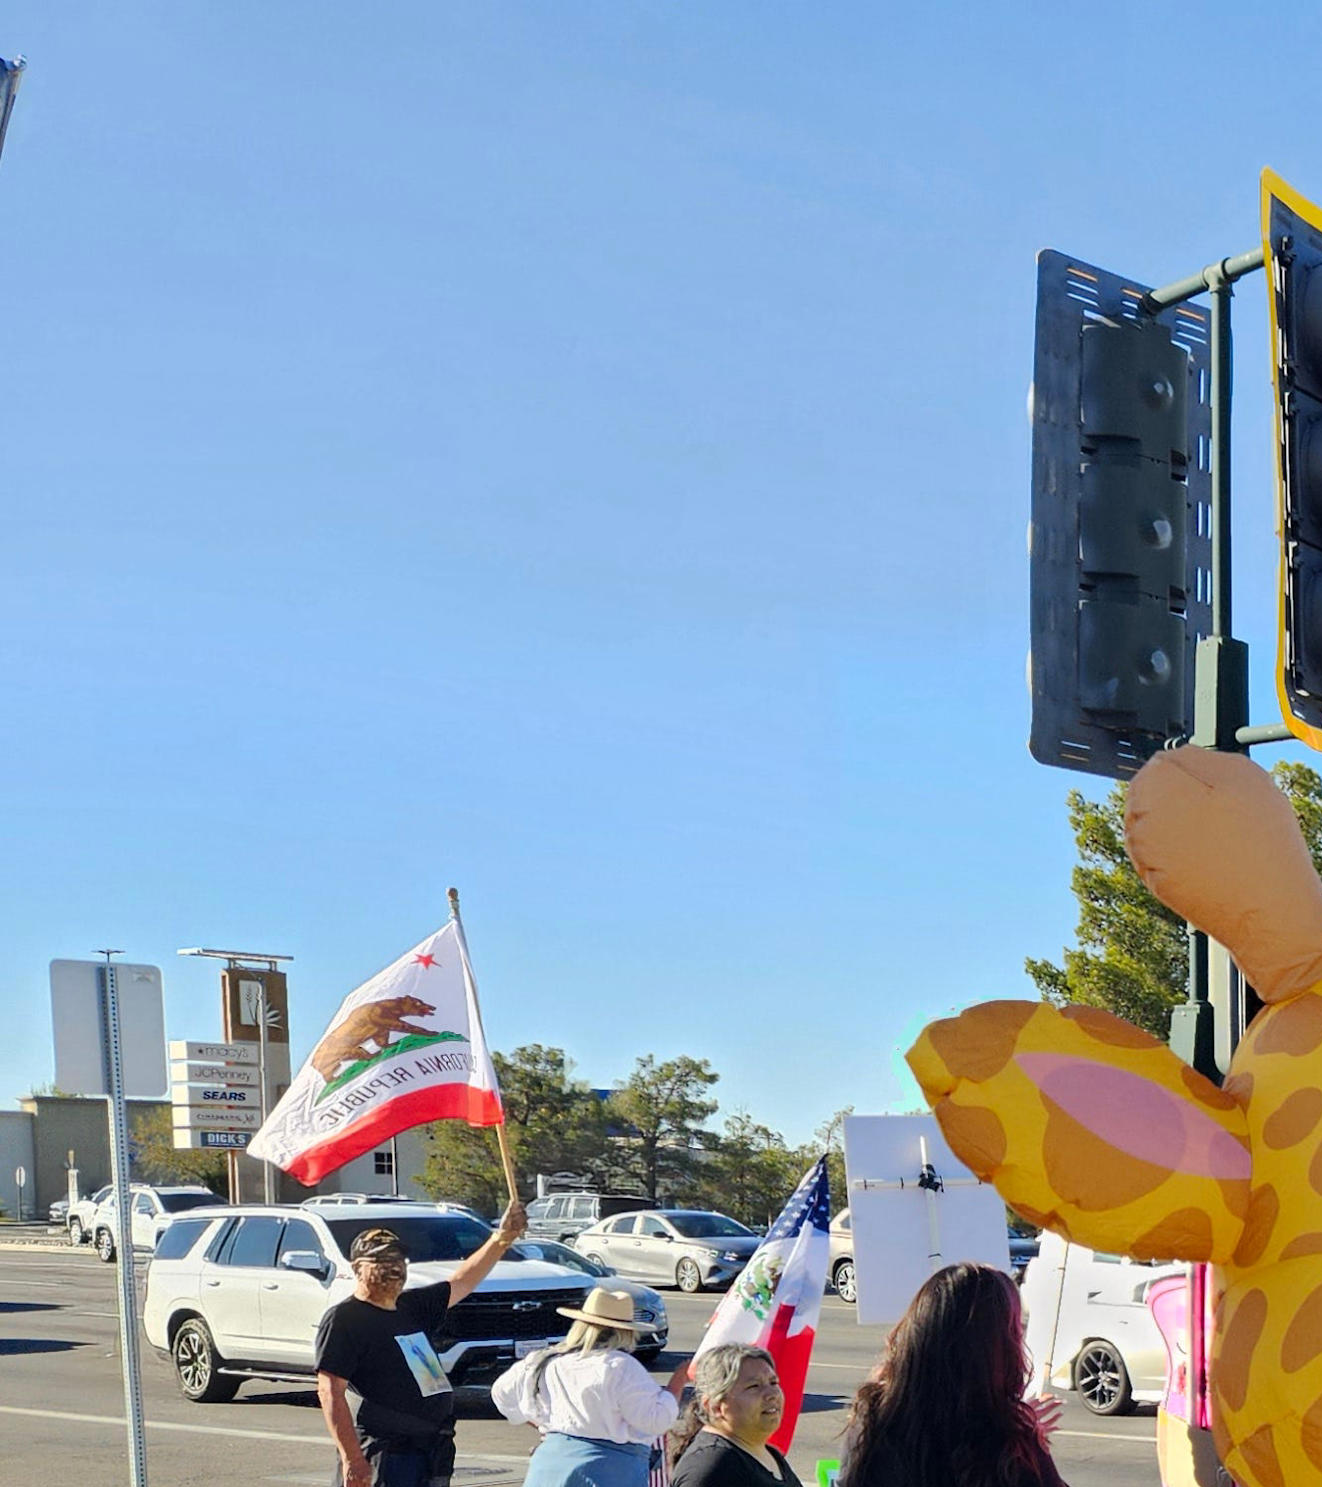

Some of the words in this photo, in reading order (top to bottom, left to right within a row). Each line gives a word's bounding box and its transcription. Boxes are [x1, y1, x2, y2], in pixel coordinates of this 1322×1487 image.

[205, 1047, 249, 1060] macy's
[195, 1067, 253, 1082] JCPenney
[202, 1090, 247, 1102] SEARS
